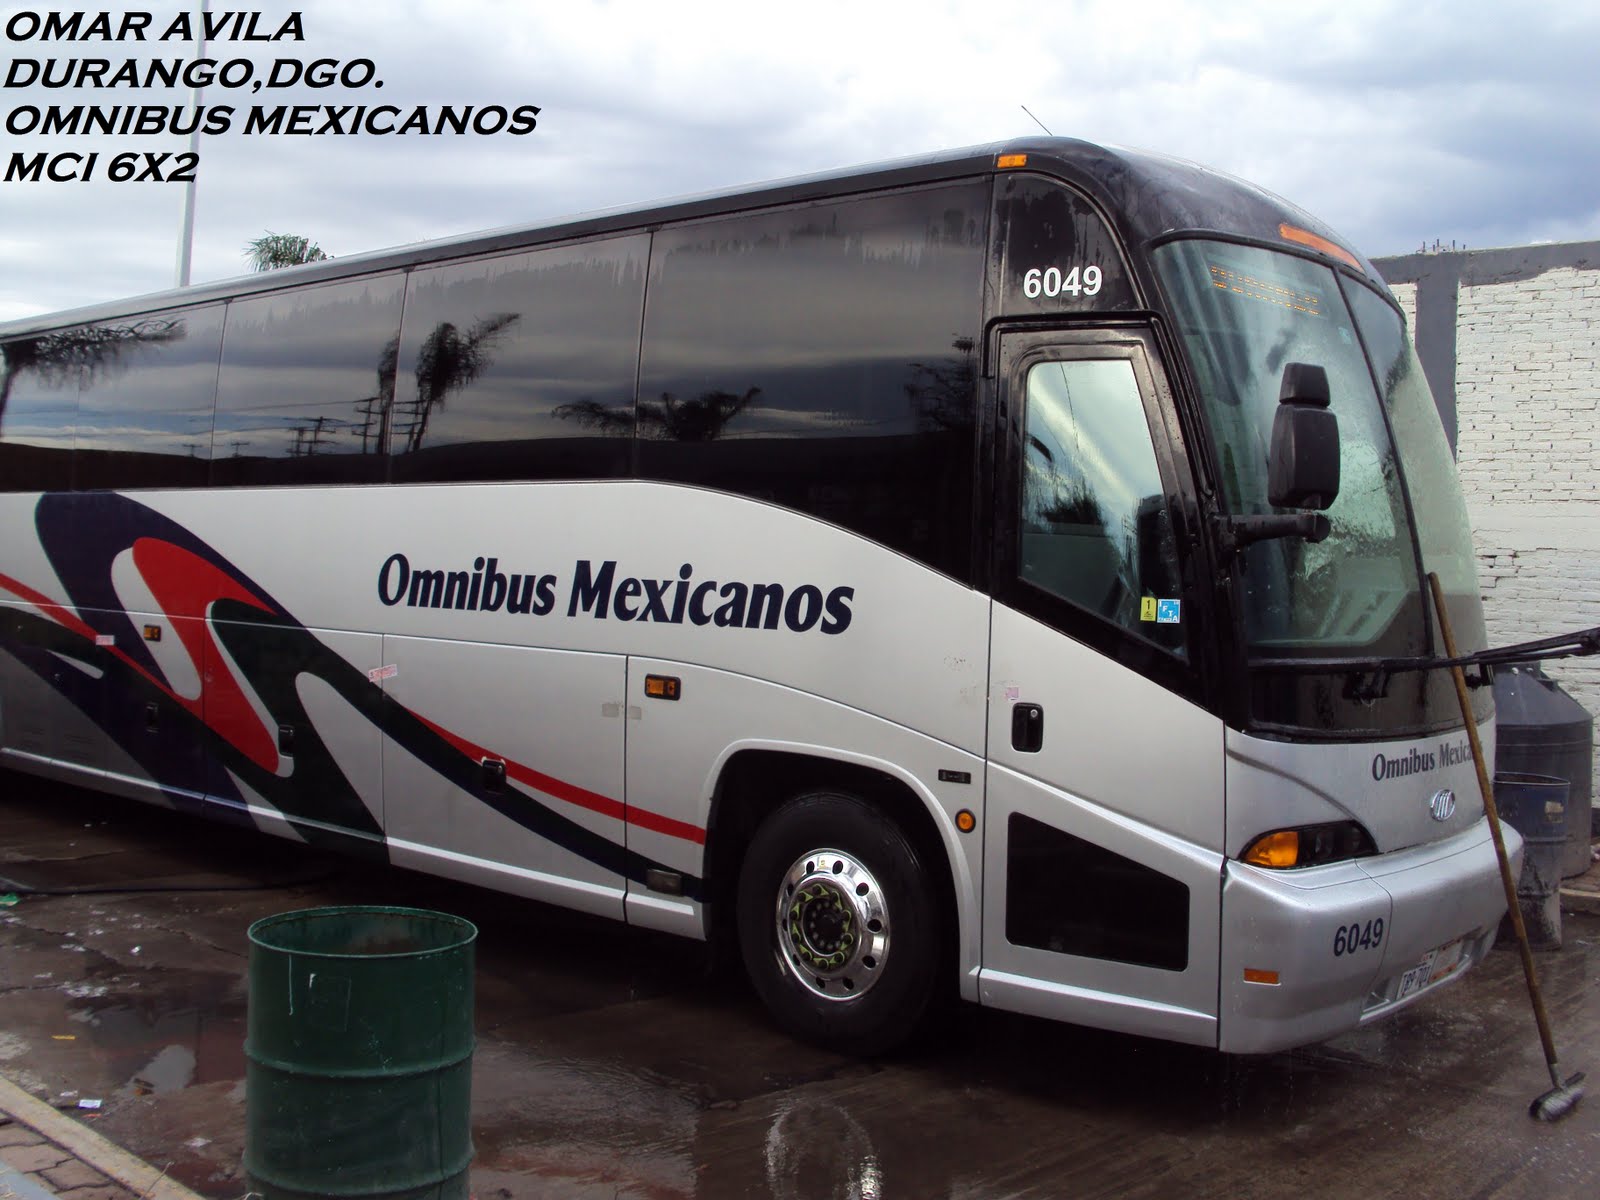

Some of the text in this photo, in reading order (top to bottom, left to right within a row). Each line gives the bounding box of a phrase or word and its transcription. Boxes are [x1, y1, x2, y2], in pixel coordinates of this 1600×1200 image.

[1023, 265, 1102, 299] 6049
[378, 553, 855, 635] Omnibus Mexicanos
[1372, 740, 1482, 782] Omnibus Mexica
[1333, 917, 1384, 957] 6049
